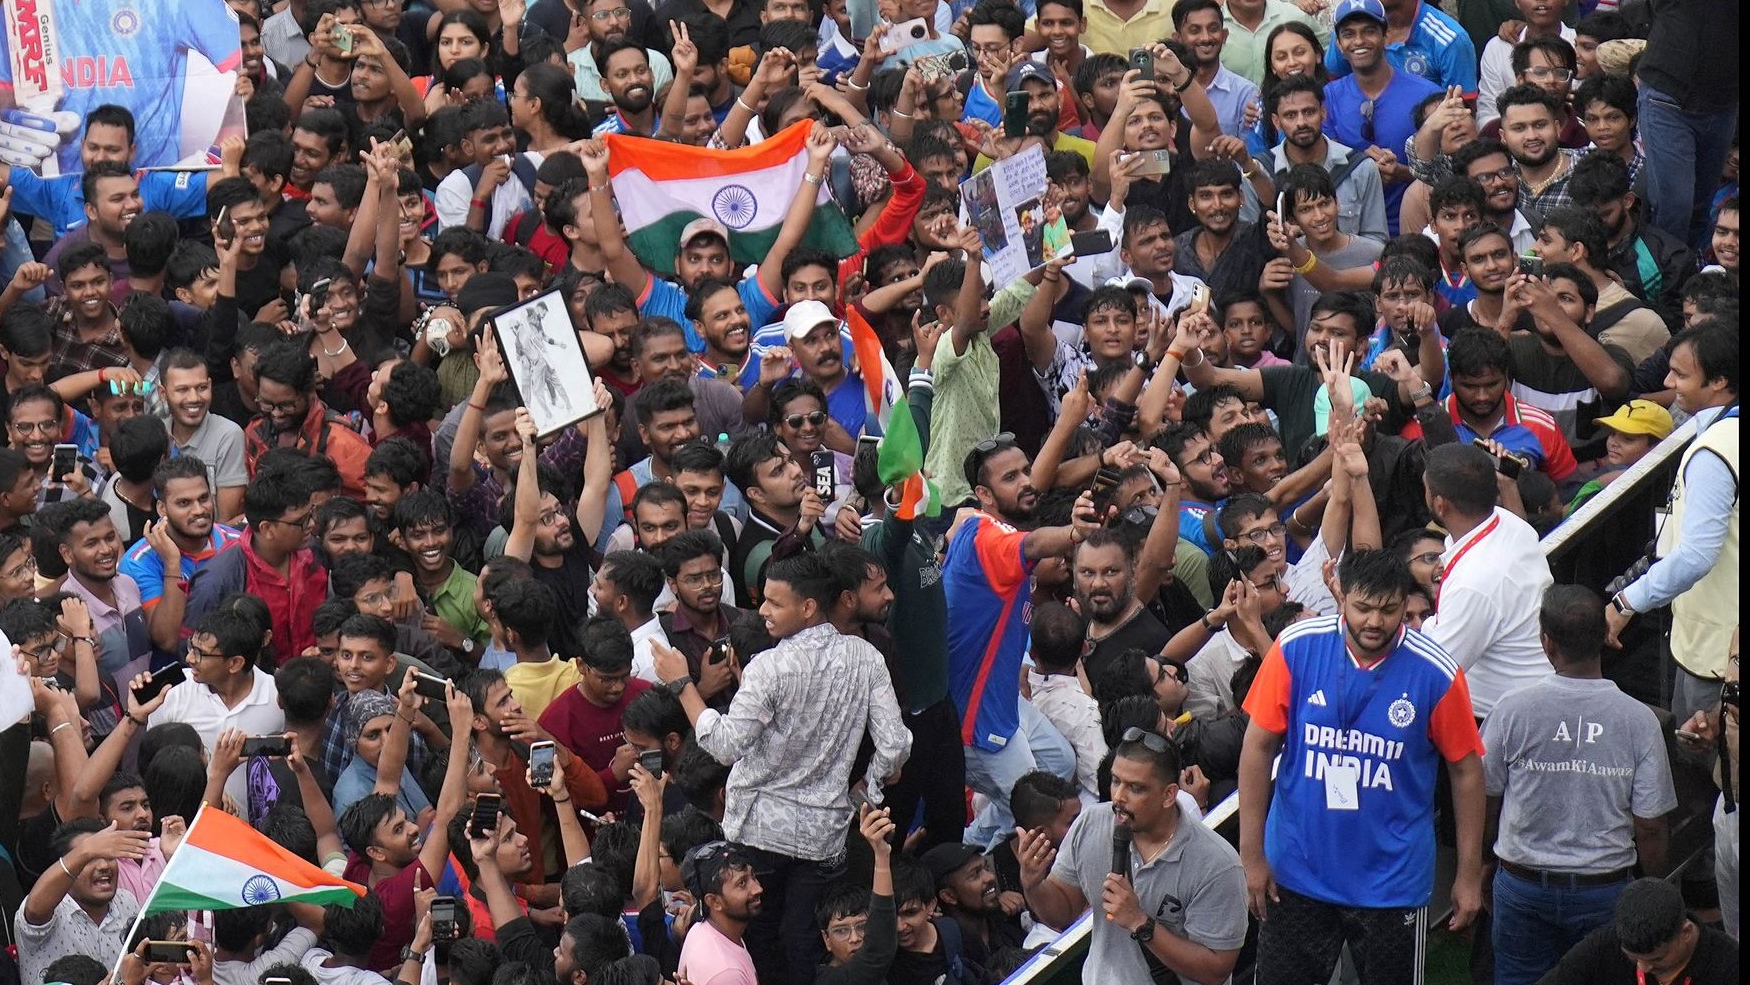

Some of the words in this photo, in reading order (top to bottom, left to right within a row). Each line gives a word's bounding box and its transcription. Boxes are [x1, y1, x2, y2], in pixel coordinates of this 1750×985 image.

[40, 14, 52, 66] Genius
[61, 55, 134, 89] NDIA
[1304, 722, 1404, 760] DREAM11
[1304, 749, 1394, 792] INDIA
